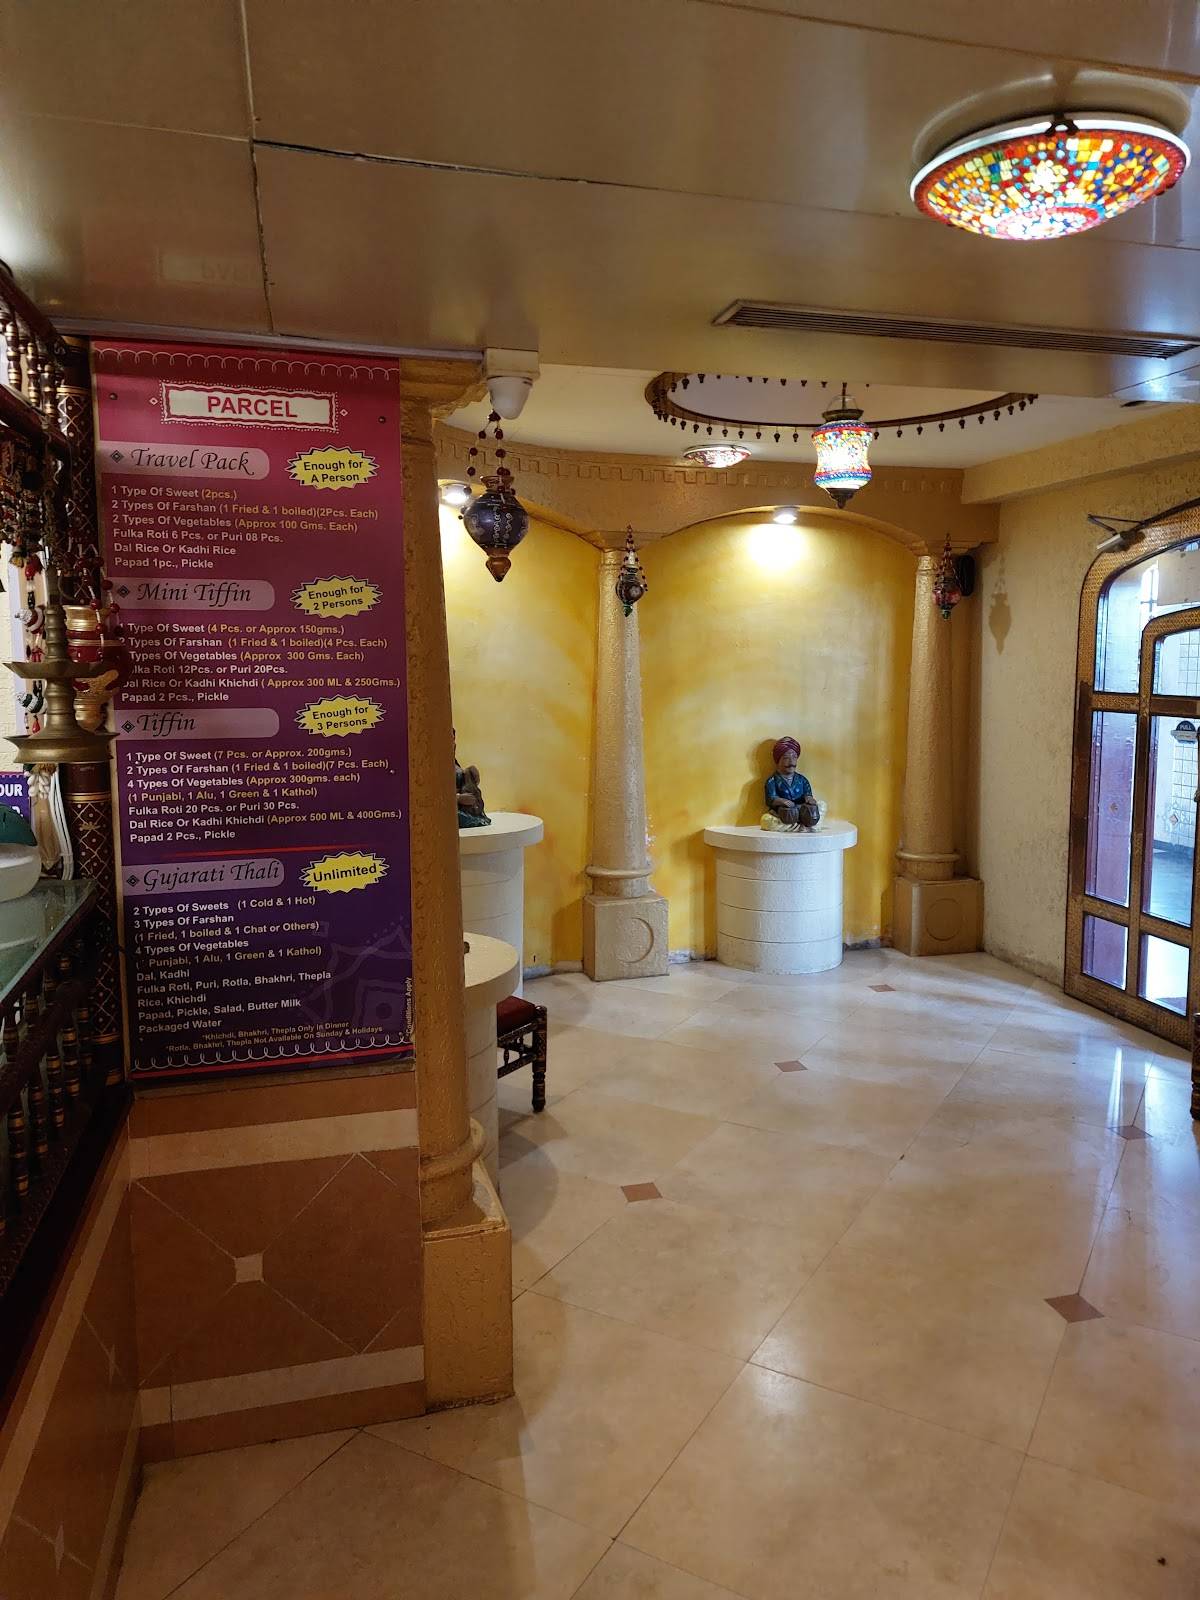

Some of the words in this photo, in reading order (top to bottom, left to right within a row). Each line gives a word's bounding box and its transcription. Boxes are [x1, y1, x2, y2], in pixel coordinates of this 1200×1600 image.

[207, 396, 298, 418] PARCEL
[130, 448, 199, 468] Travel
[201, 448, 254, 476] Pack
[304, 460, 345, 472] Enough
[348, 459, 363, 470] for
[311, 474, 319, 482] A
[321, 472, 360, 482] Person
[120, 486, 146, 496] Type
[166, 488, 198, 498] Sweet
[202, 489, 238, 500] (2pcs.)
[120, 500, 153, 511] Types
[172, 502, 216, 512] Farshan
[232, 504, 258, 514] Fried
[350, 509, 378, 520] Each)
[122, 514, 154, 526] Types
[172, 516, 232, 528] Vegetables
[235, 518, 276, 530] (Approx
[300, 521, 326, 530] Gms.
[329, 522, 358, 533] Each)
[114, 528, 144, 538] Fulka
[146, 530, 168, 539] Roti
[182, 530, 204, 540] Pcs.
[222, 532, 242, 541] Puri
[260, 534, 284, 542] Pcs.
[114, 543, 132, 552] Dal
[136, 544, 160, 553] Rice
[178, 545, 210, 554] Kadhi
[213, 546, 236, 555] Rice
[114, 557, 149, 569] Papad
[153, 558, 178, 568] 1pc.,
[181, 559, 214, 568] Pickle
[137, 583, 188, 601] Mini
[194, 582, 251, 608] Tiffin
[308, 587, 348, 600] Enough
[350, 584, 364, 595] for
[314, 602, 320, 611] 2
[322, 597, 364, 610] Persons
[128, 623, 154, 634] Type
[172, 624, 204, 632] Sweet
[220, 624, 242, 633] Pcs.
[259, 625, 296, 636] Approx
[300, 625, 345, 636] 150gms.)
[128, 637, 160, 648] Types
[180, 638, 222, 647] Farshan
[240, 638, 268, 647] Fried
[336, 638, 358, 647] Pcs.
[360, 638, 388, 649] Each)
[129, 651, 160, 662] Types
[180, 651, 238, 662] Vegetables
[240, 651, 281, 662] (Approx
[287, 652, 304, 660] 300
[308, 652, 334, 660] Gms.
[336, 652, 364, 662] Each)
[154, 664, 175, 674] Roti
[230, 665, 252, 674] Puri
[254, 665, 288, 674] 20Pcs.
[142, 679, 166, 688] Rice
[184, 678, 216, 688] Kadhi
[218, 678, 258, 688] Khichdi
[267, 678, 305, 688] Approx
[306, 678, 324, 686] 300
[354, 678, 400, 688] 250Gms.)
[121, 692, 156, 703] Papad
[168, 692, 194, 702] Pcs.,
[197, 692, 230, 702] Pickle
[312, 708, 352, 720] Enough
[354, 705, 368, 715] for
[136, 712, 196, 737] Tiffin
[317, 722, 324, 731] 3
[326, 717, 368, 730] Persons
[136, 752, 160, 763] Type
[180, 752, 212, 760] Sweet
[226, 750, 249, 759] Pcs.
[265, 750, 304, 760] Approx.
[307, 748, 352, 758] 200gms.)
[136, 766, 168, 776] Types
[186, 764, 228, 774] Farshan
[244, 762, 270, 772] Fried
[338, 760, 359, 769] Pcs.
[362, 760, 388, 770] Each)
[137, 780, 168, 790] Types
[186, 777, 244, 788] Vegetables
[246, 776, 287, 786] (Approx
[290, 774, 330, 784] 300gms.
[334, 773, 360, 784] each)
[142, 792, 185, 802] Punjabi,
[196, 791, 216, 800] Alu,
[228, 790, 260, 799] Green
[282, 787, 318, 798] Kathol)
[128, 806, 158, 816] Fulka
[161, 805, 183, 814] Roti
[200, 804, 223, 814] Pcs.
[240, 803, 260, 812] Puri
[278, 802, 300, 810] Pcs.
[130, 820, 147, 830] Dal
[150, 820, 174, 829] Rice
[192, 817, 222, 826] Kadhi
[226, 816, 264, 825] Khichdi
[268, 814, 307, 825] (Approx
[310, 812, 327, 822] 500
[357, 810, 402, 820] 400Gms.)
[130, 833, 164, 844] Papad
[176, 832, 202, 842] Pcs.,
[204, 830, 236, 840] Pickle
[143, 864, 225, 892] Gujarati
[230, 860, 280, 882] Thali
[313, 864, 378, 884] Unlimited
[142, 906, 174, 916] Types
[192, 902, 229, 912] Sweets
[250, 898, 274, 908] Cold
[294, 896, 316, 906] Hot)
[143, 919, 174, 930] Types
[192, 914, 234, 924] Farshan
[148, 930, 178, 941] Fried,
[190, 928, 222, 938] boiled
[244, 924, 267, 934] Chat
[282, 920, 320, 932] Others)
[144, 945, 176, 956] Types
[193, 940, 249, 951] Vegetables
[149, 956, 192, 968] Punjabi,
[203, 954, 222, 963] Alu,
[234, 952, 264, 960] Green
[286, 946, 322, 957] Kathol)
[136, 972, 156, 981] Dal,
[160, 969, 190, 979] Kadhi
[138, 985, 166, 994] Fulka
[168, 982, 192, 992] Roti,
[196, 980, 220, 990] Puri,
[298, 970, 332, 981] Thepla
[138, 998, 164, 1008] Rice,
[166, 994, 206, 1004] Khichdi
[138, 1010, 174, 1020] Papad,
[177, 1006, 210, 1016] Pickle,
[214, 1004, 244, 1014] Salad,
[248, 1001, 279, 1011] Butter
[281, 998, 302, 1008] Milk
[138, 1021, 190, 1033] Packaged
[192, 1020, 222, 1028] Water
